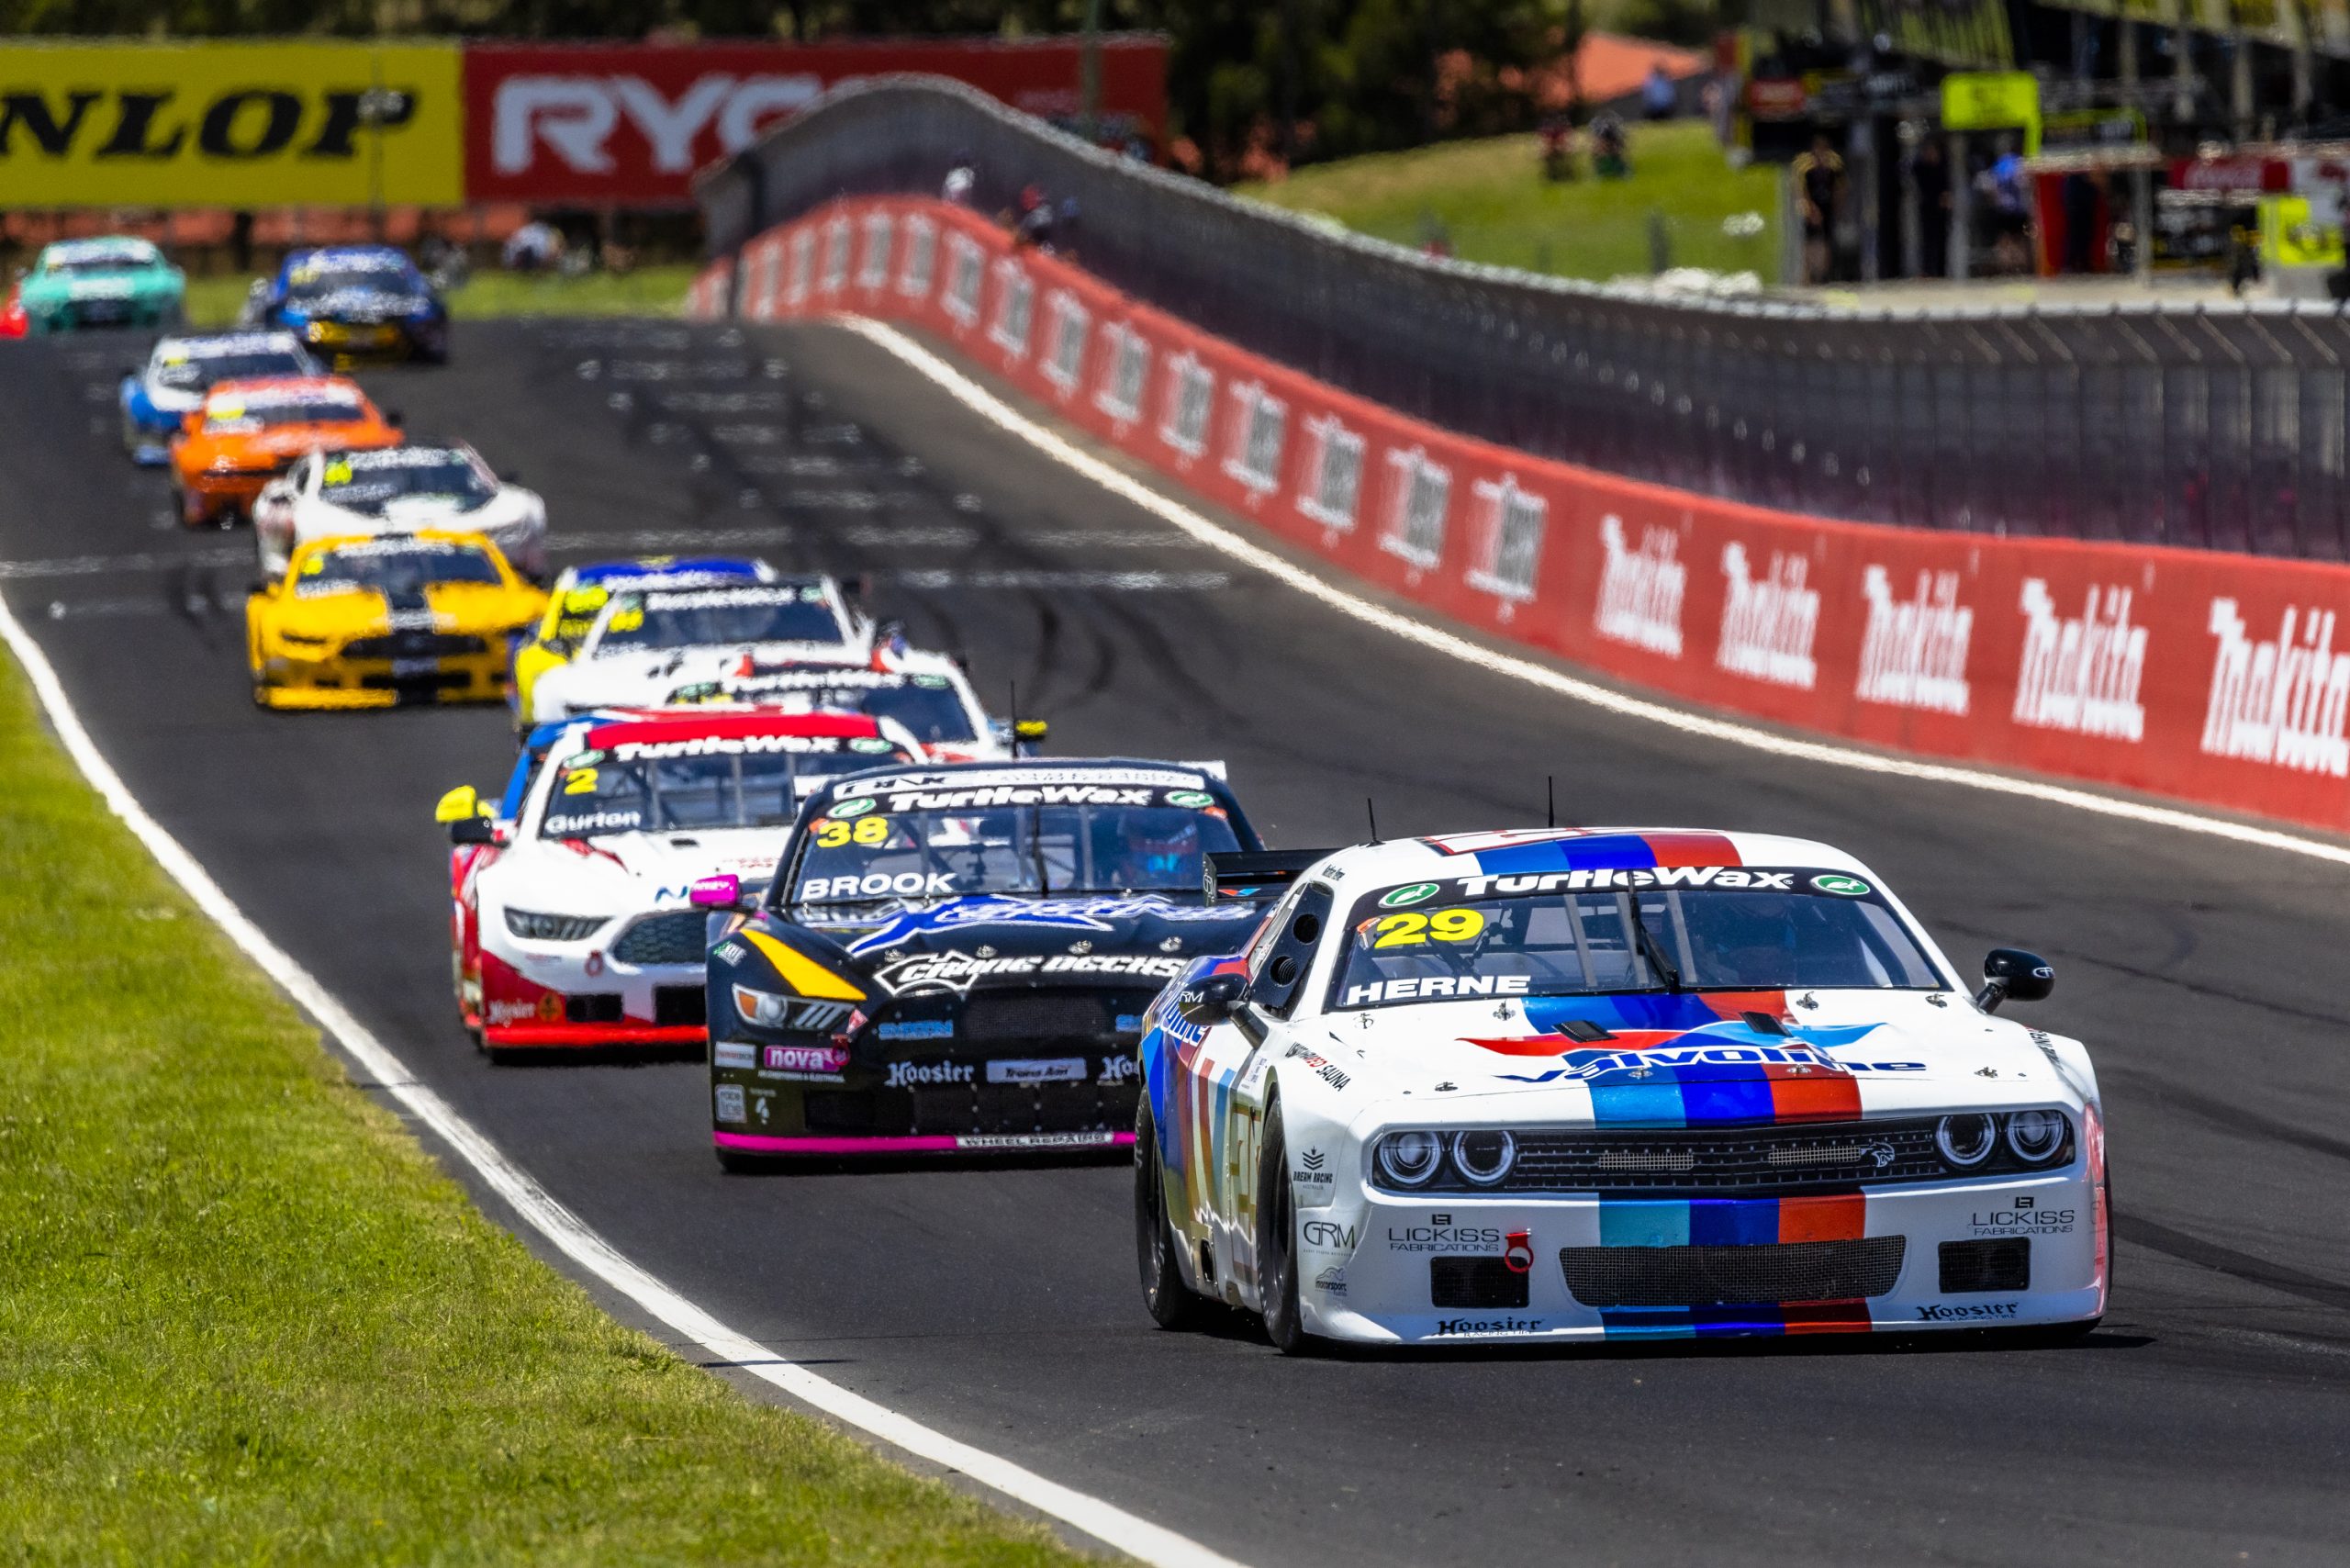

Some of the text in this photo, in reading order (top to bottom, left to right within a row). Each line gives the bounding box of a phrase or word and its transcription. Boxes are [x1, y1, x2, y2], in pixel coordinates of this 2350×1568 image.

[564, 767, 599, 795] 2
[888, 786, 1153, 812] TurtleWax
[816, 816, 888, 848] 38
[800, 873, 957, 901] BROOK
[1457, 867, 1794, 896] TurtleWax
[1374, 909, 1484, 948] 29
[1346, 976, 1531, 1006] HERNE
[770, 1049, 824, 1069] nova
[884, 1060, 974, 1087] Hoosier
[1315, 1064, 1351, 1092] SAUNA
[1313, 1172, 1333, 1183] RACING
[1972, 1210, 2075, 1226] LICKISS
[1974, 1224, 2073, 1236] FABRICATIONS
[1304, 1221, 1356, 1249] GRM
[1388, 1227, 1500, 1243] LICKISS
[1390, 1242, 1499, 1252] FABRICATIONS
[1915, 1302, 2020, 1320] Hoosier
[1433, 1316, 1547, 1337] Hoosier
